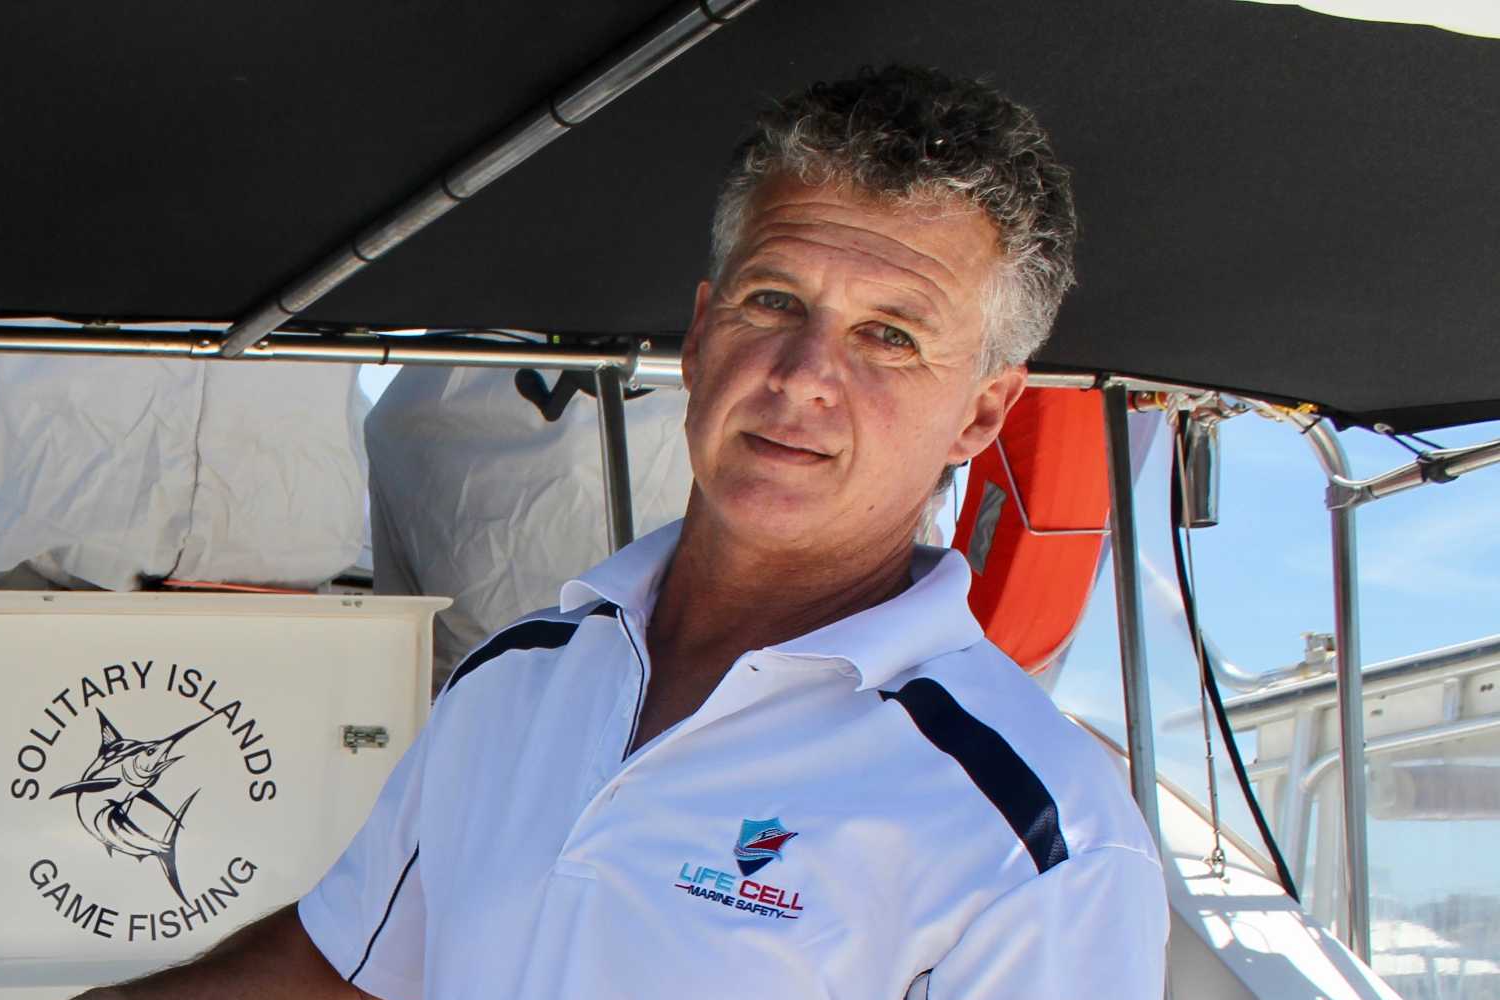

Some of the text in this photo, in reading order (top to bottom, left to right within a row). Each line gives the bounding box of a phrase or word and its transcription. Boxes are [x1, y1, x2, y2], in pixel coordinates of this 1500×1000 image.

[11, 660, 276, 802] SOLITARY ISLANDS
[29, 857, 258, 942] GAME FISHING
[679, 862, 803, 911] LIFE CELL
[687, 885, 784, 919] MARINE SAFETY
